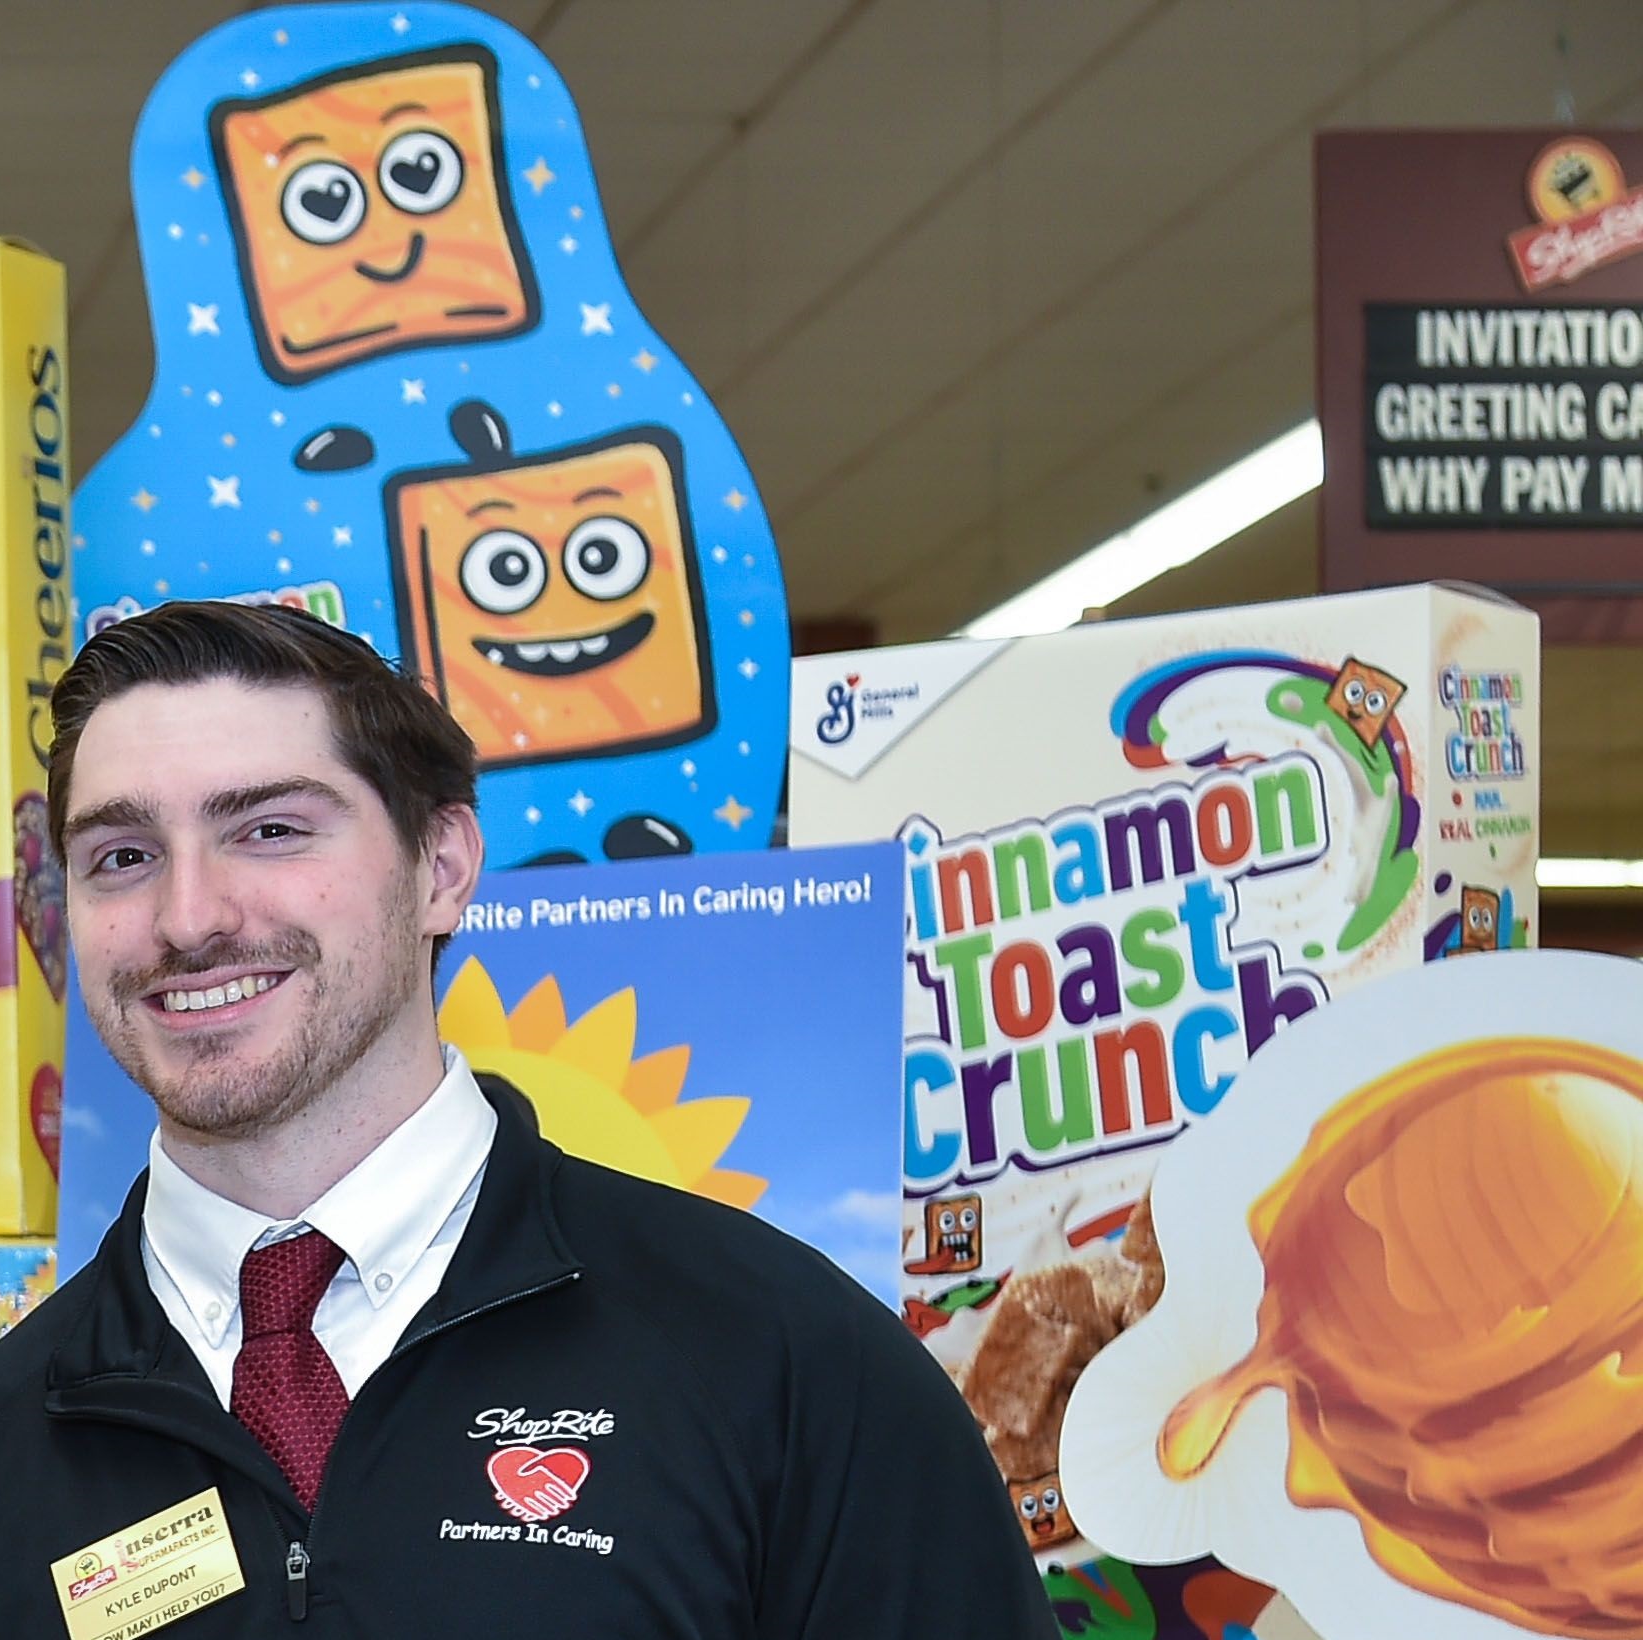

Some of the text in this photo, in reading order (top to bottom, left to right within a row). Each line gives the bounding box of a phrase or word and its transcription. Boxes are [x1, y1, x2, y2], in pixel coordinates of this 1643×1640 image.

[1417, 313, 1643, 371] INVITATIO
[1374, 385, 1585, 442] GREETING
[1379, 454, 1587, 513] WHY PAY
[911, 763, 1318, 941] innamon
[530, 891, 651, 929] Partners
[659, 889, 685, 915] In
[693, 884, 784, 916] Caring
[792, 875, 872, 906] Hero!
[936, 879, 1235, 1050] Toast
[468, 1408, 614, 1445] ShopRite
[440, 1519, 614, 1554] Partners In Caring
[105, 1565, 197, 1617] KYLE DUPONT
[127, 1617, 154, 1638] MAY
[164, 1599, 191, 1620] HELP
[193, 1583, 226, 1606] YOU?
